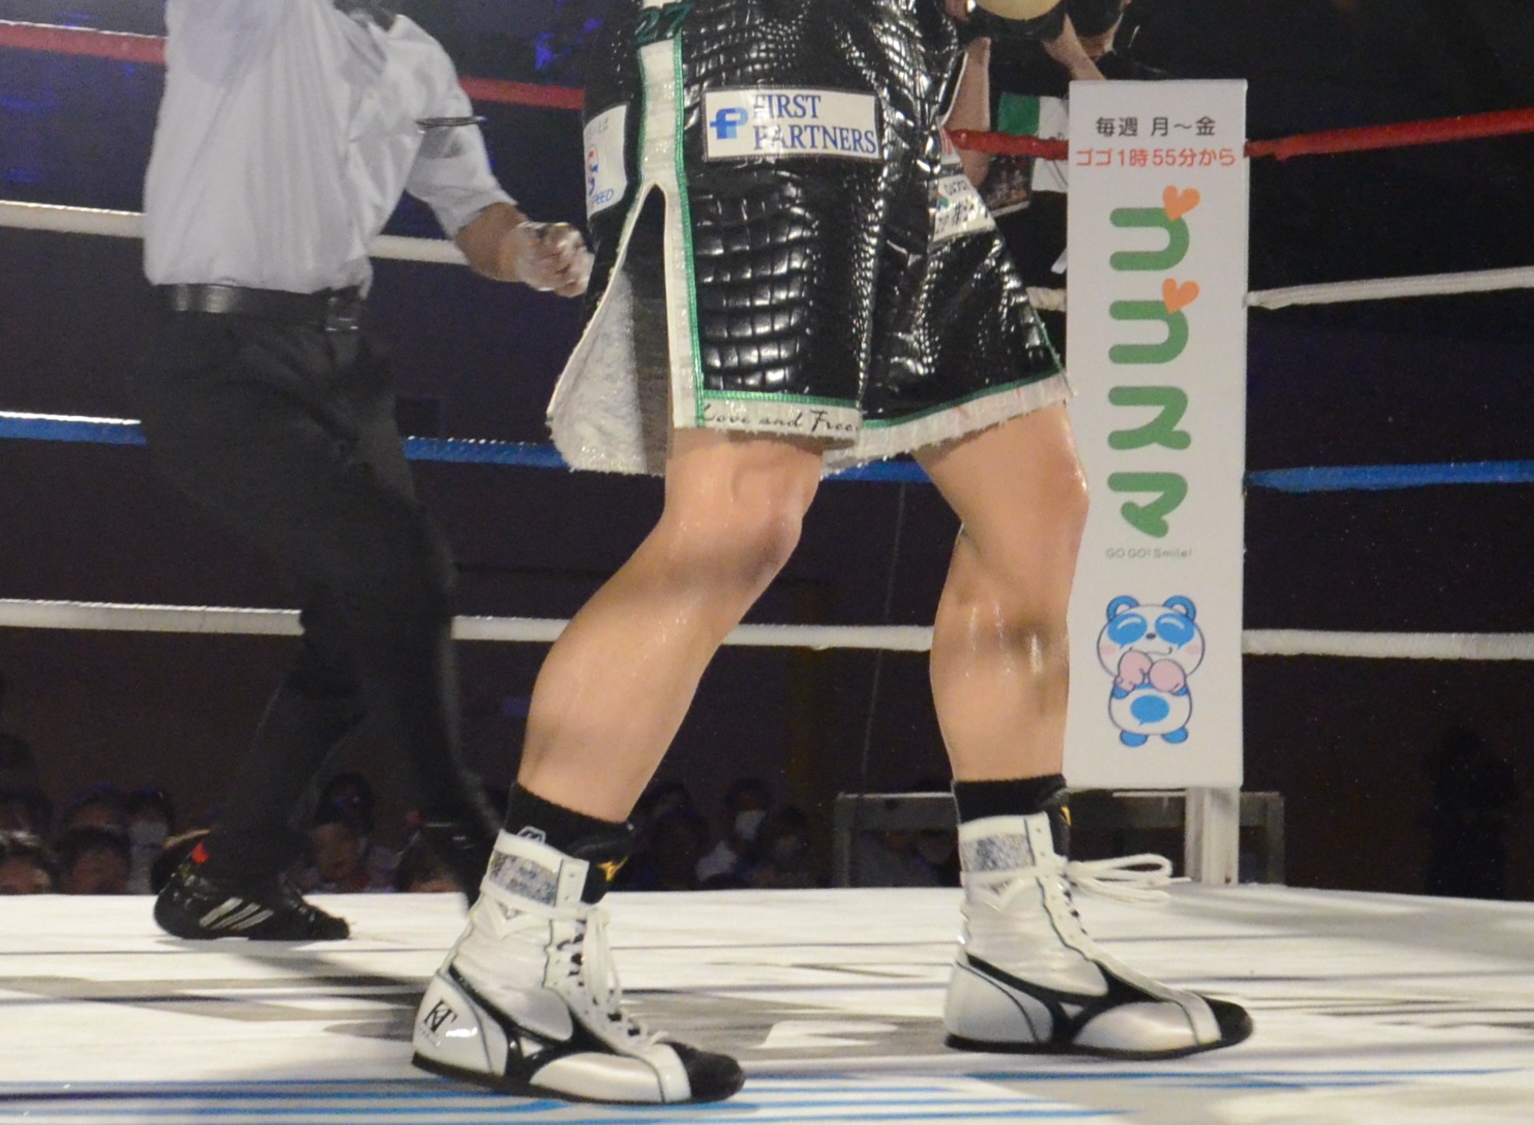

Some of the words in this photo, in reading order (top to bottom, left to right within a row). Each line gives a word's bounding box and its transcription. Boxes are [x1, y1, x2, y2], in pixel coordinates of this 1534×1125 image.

[753, 93, 821, 119] FIRST
[1096, 117, 1138, 137] 毎週
[753, 124, 877, 155] PARTNERS
[1107, 185, 1200, 538] ゴゴスマ
[758, 412, 803, 428] and
[1106, 547, 1125, 559] GO
